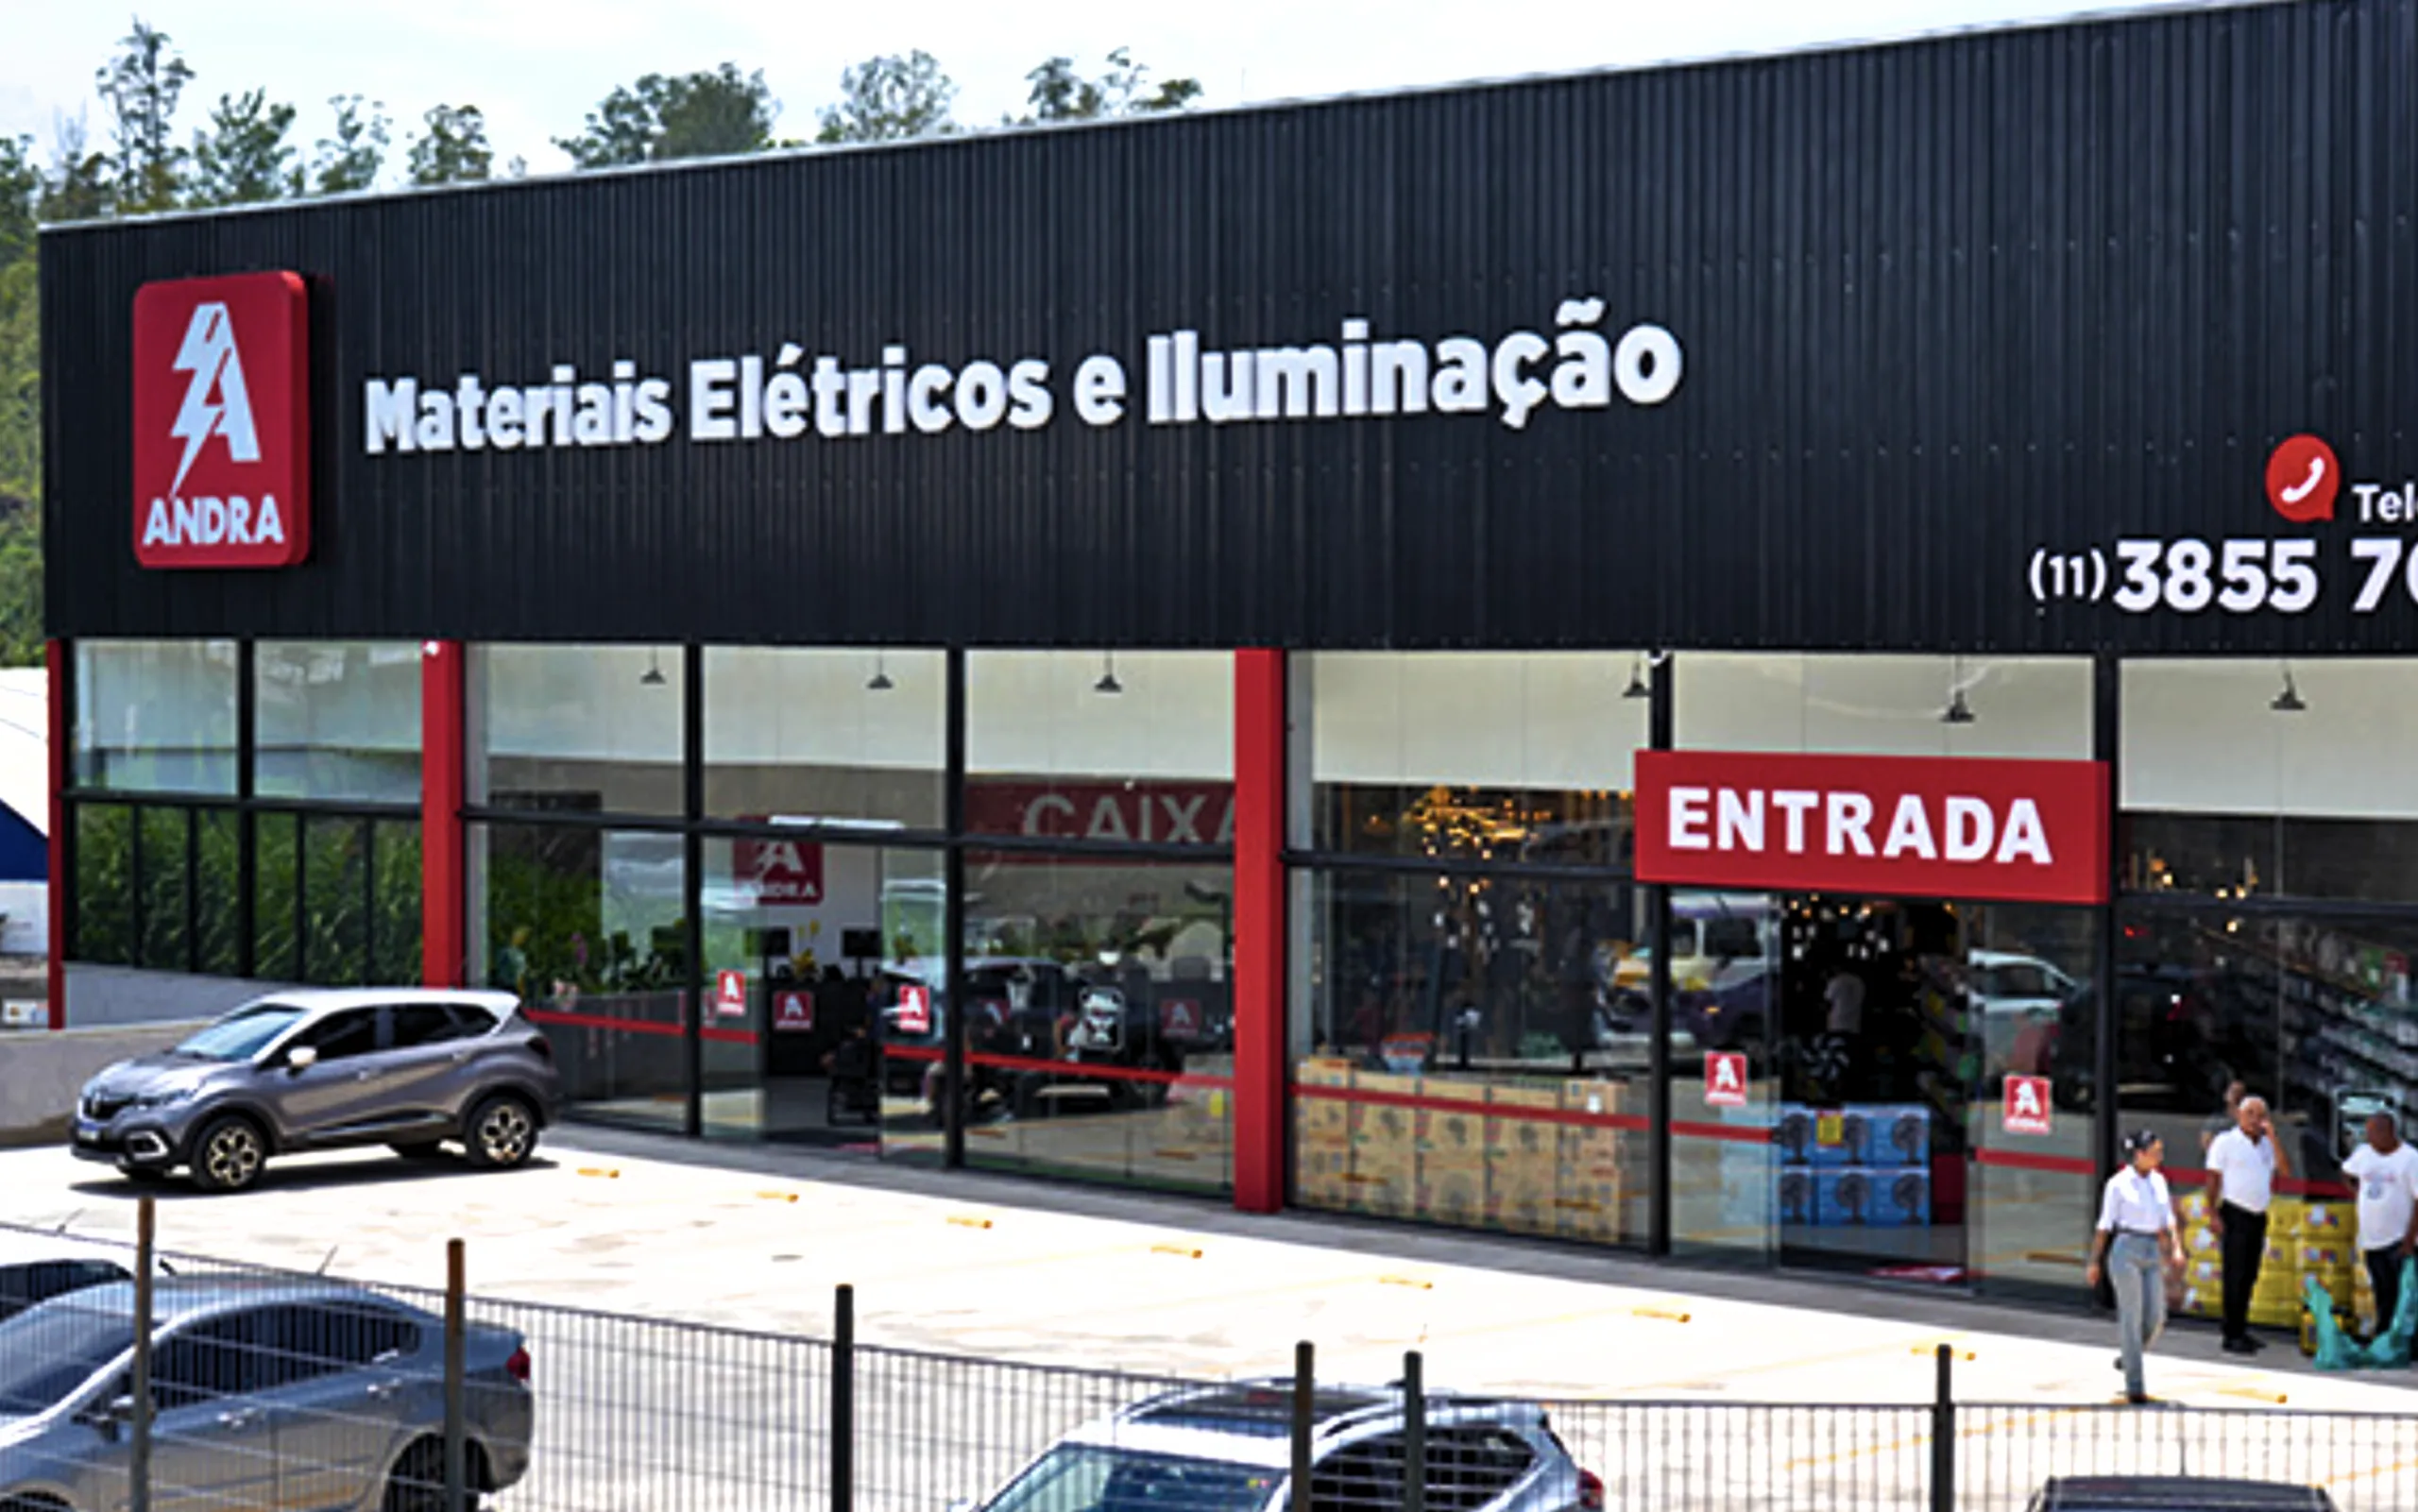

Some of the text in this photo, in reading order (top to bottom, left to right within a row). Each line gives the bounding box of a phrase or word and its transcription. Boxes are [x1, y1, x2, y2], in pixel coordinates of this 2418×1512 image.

[365, 297, 1682, 455] Materiais Elétricos e Iluminação
[143, 494, 284, 546] ANDRA
[2351, 481, 2418, 522] Tel
[2030, 537, 2418, 613] (11) 3855 7
[1668, 786, 2053, 865] ENTRADA
